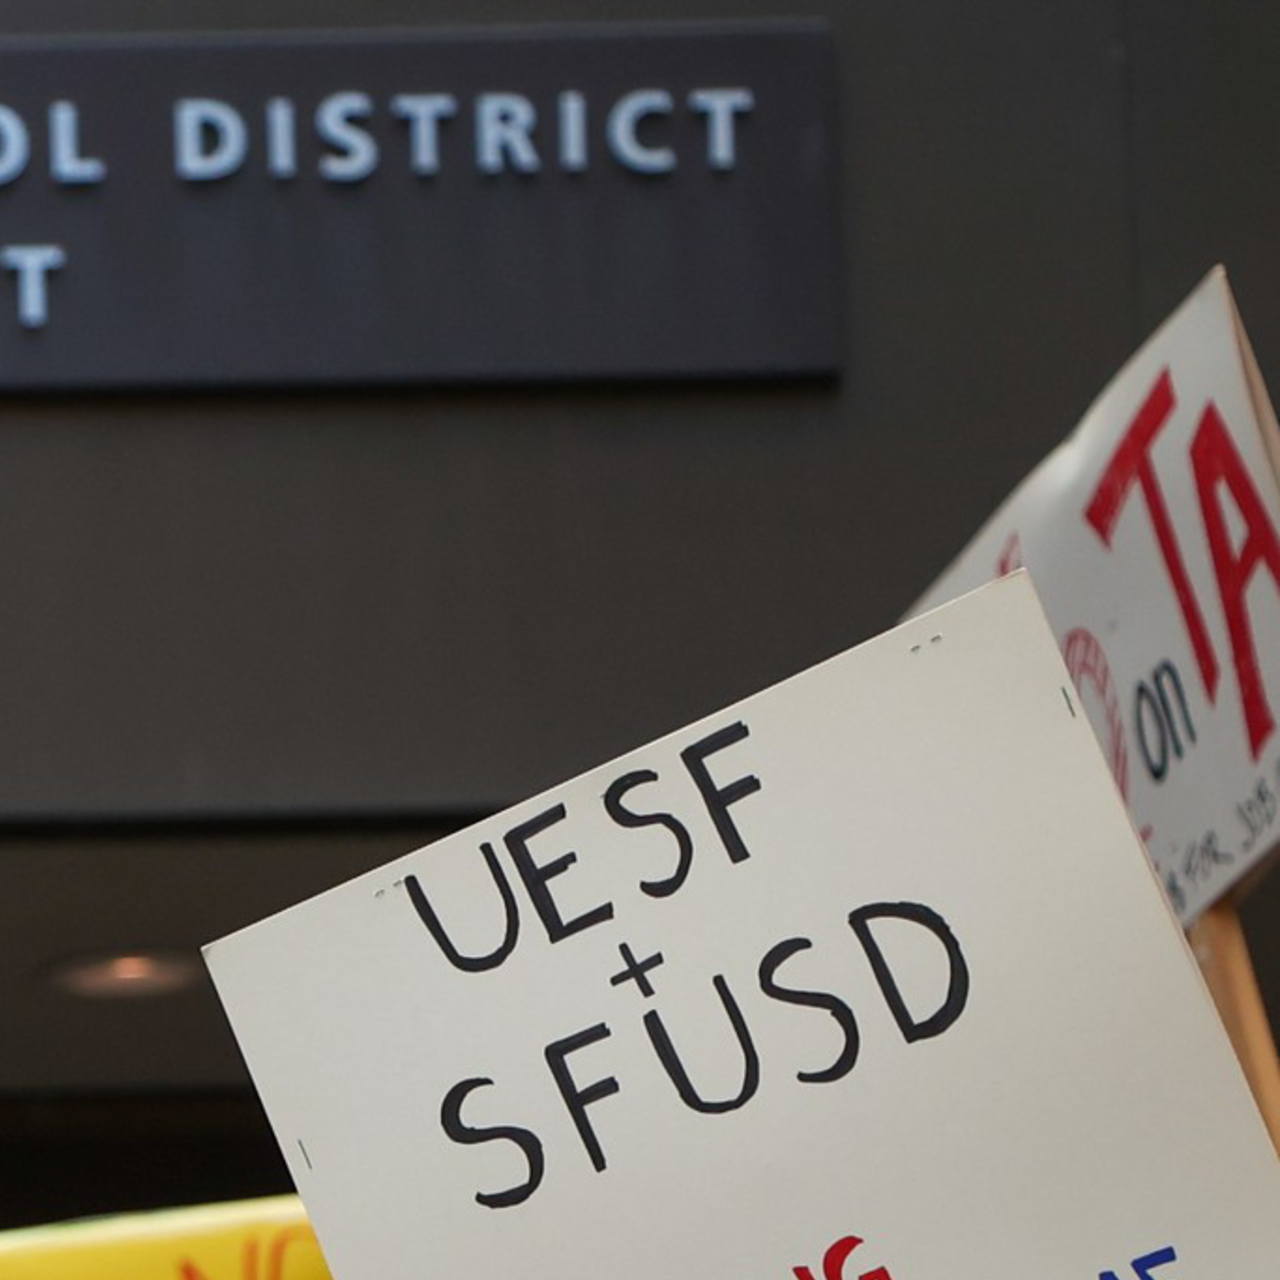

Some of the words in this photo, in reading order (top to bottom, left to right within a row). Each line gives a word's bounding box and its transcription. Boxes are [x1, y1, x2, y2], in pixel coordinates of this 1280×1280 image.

[176, 90, 750, 177] DISTRICT
[1084, 366, 1280, 763] TA
[1134, 658, 1197, 784] on
[405, 720, 762, 973] UESF
[442, 902, 969, 1208] SFUSD
[610, 943, 664, 998] +
